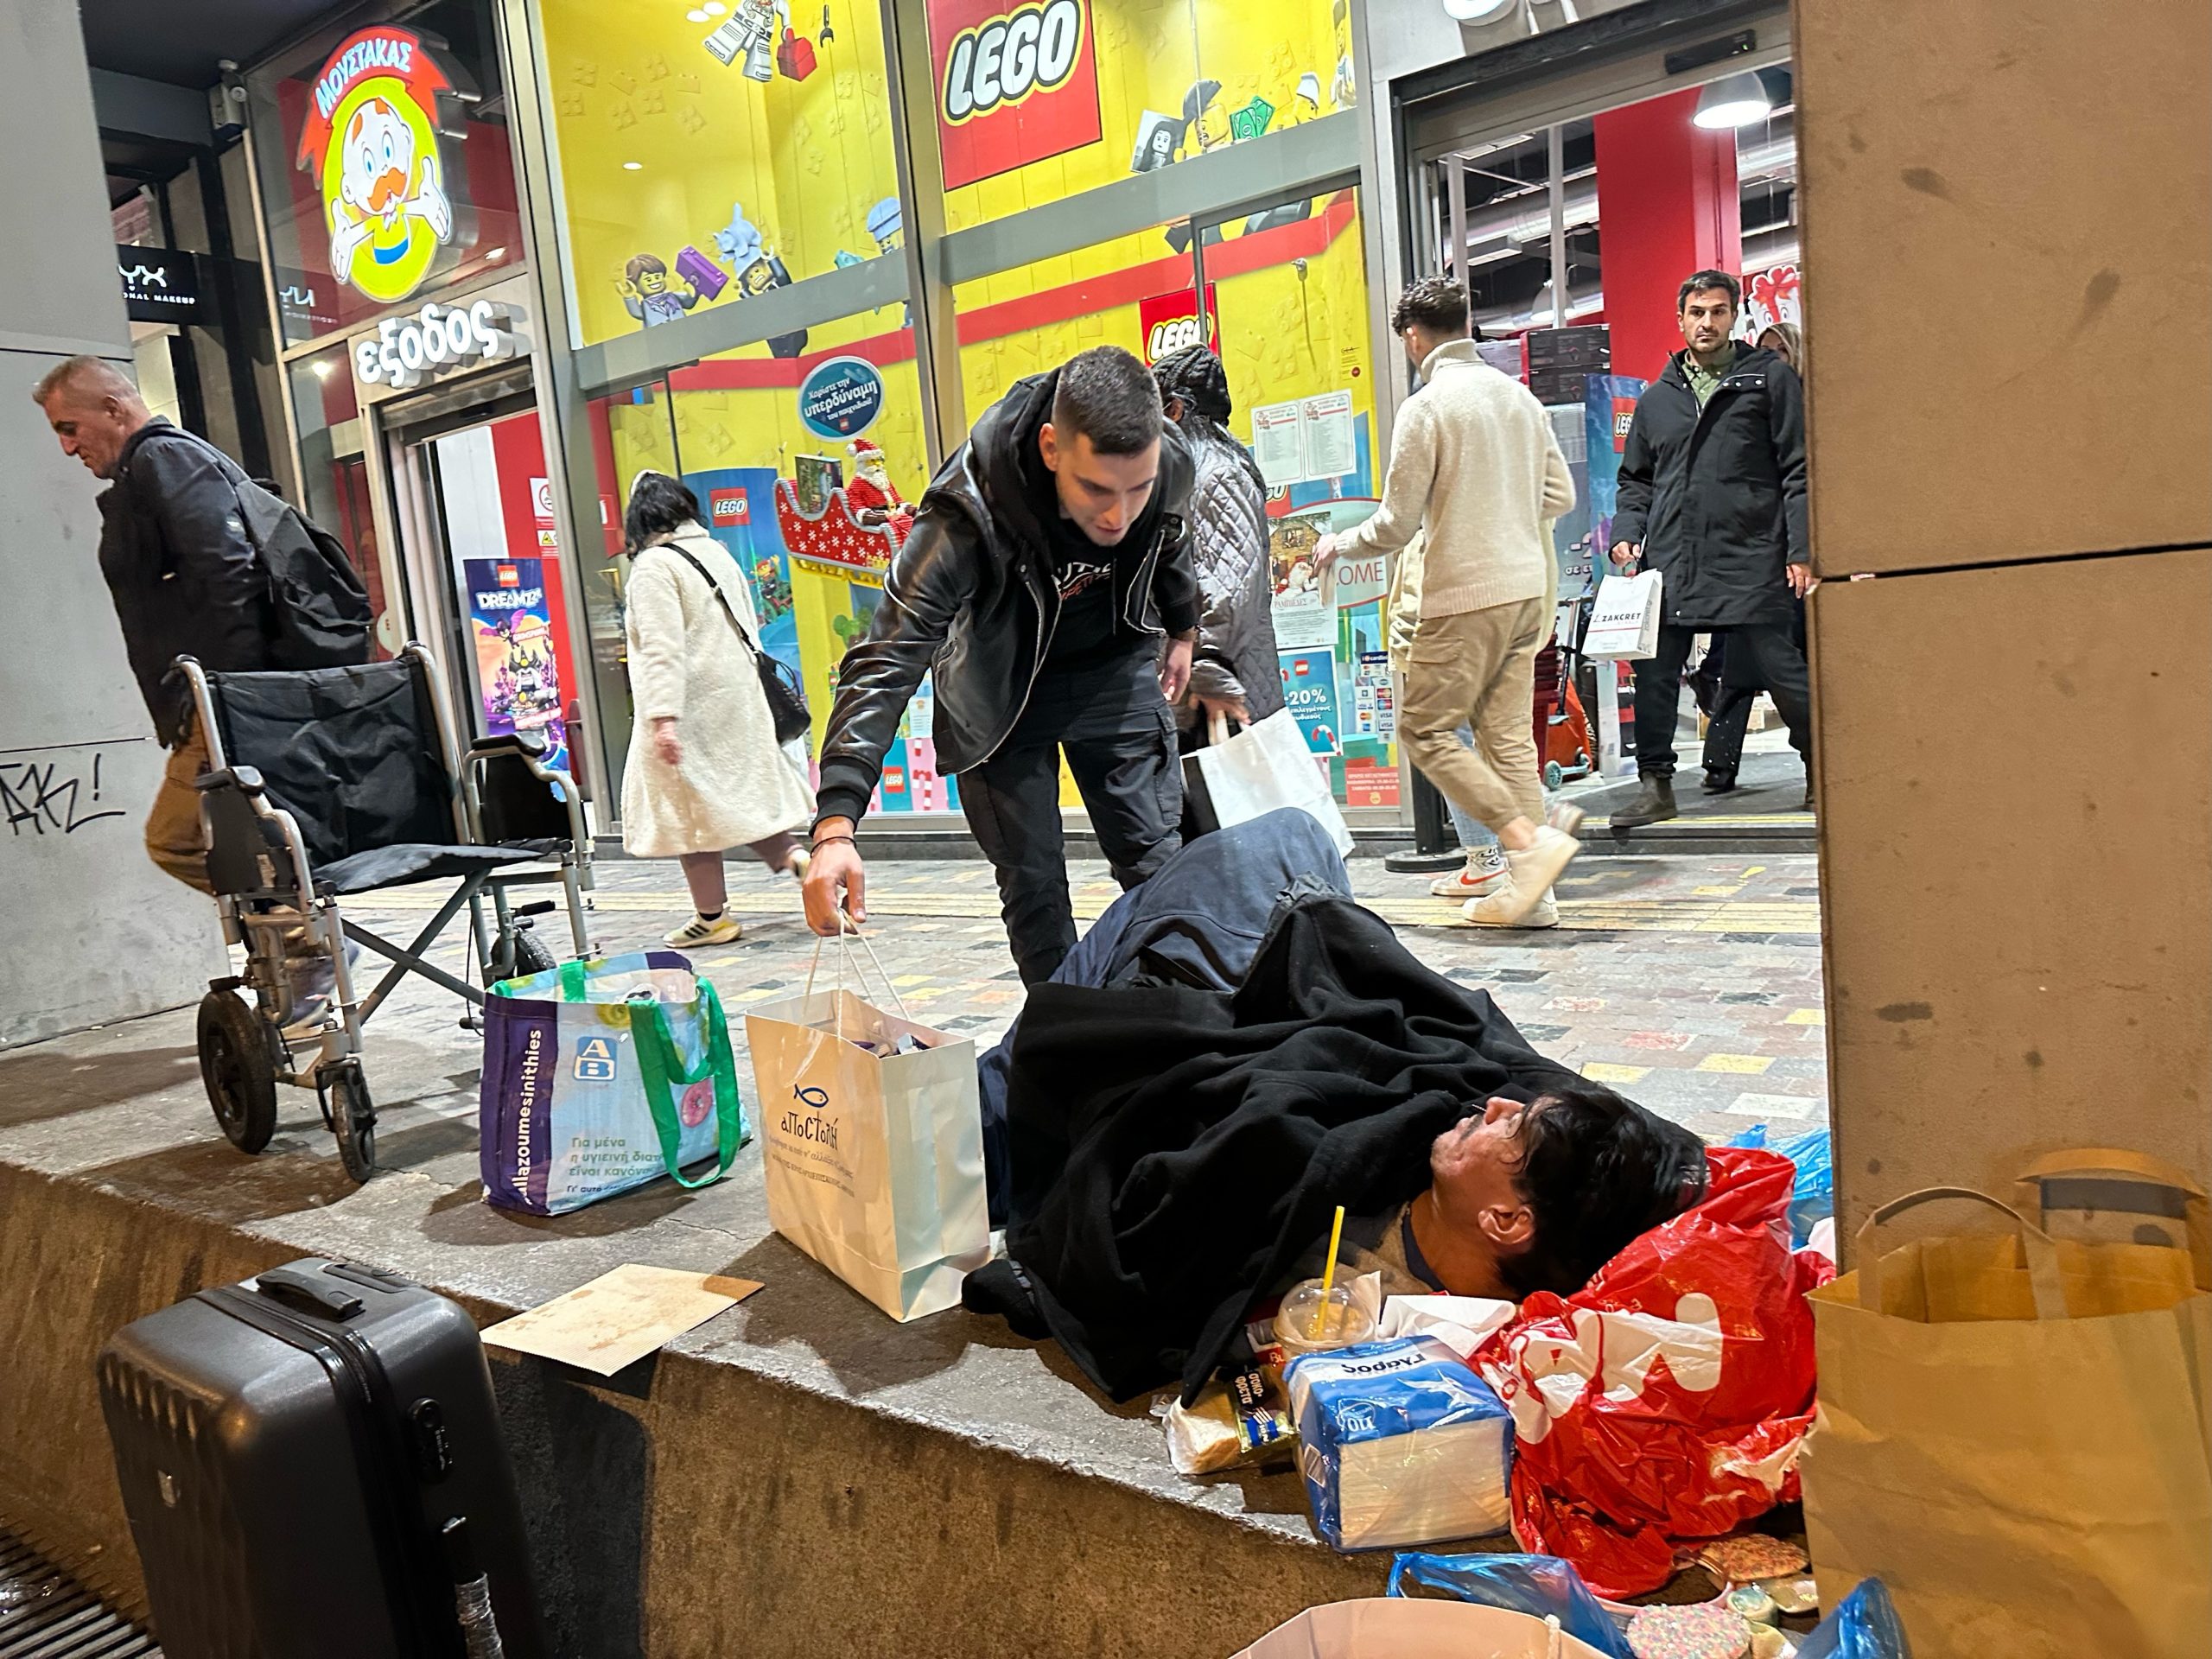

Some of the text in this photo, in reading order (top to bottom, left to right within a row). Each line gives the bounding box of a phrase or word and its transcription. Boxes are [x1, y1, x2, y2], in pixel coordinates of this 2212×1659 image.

[945, 0, 1080, 119] LEGO
[315, 38, 412, 118] ΜΟΥΣΤΑΚΑΣ
[153, 294, 195, 305] MAKEUP
[356, 299, 499, 388] εξοδος
[804, 380, 878, 418] υπερδύναμη
[715, 499, 746, 516] LEGO
[1284, 689, 1327, 706] -20%
[884, 774, 904, 786] LEGO
[571, 1136, 626, 1149] Για μένα
[570, 1154, 578, 1163] η
[582, 1151, 629, 1164] υγιεινή
[569, 1166, 601, 1177] είναι
[1341, 1353, 1427, 1375] Γλάρος
